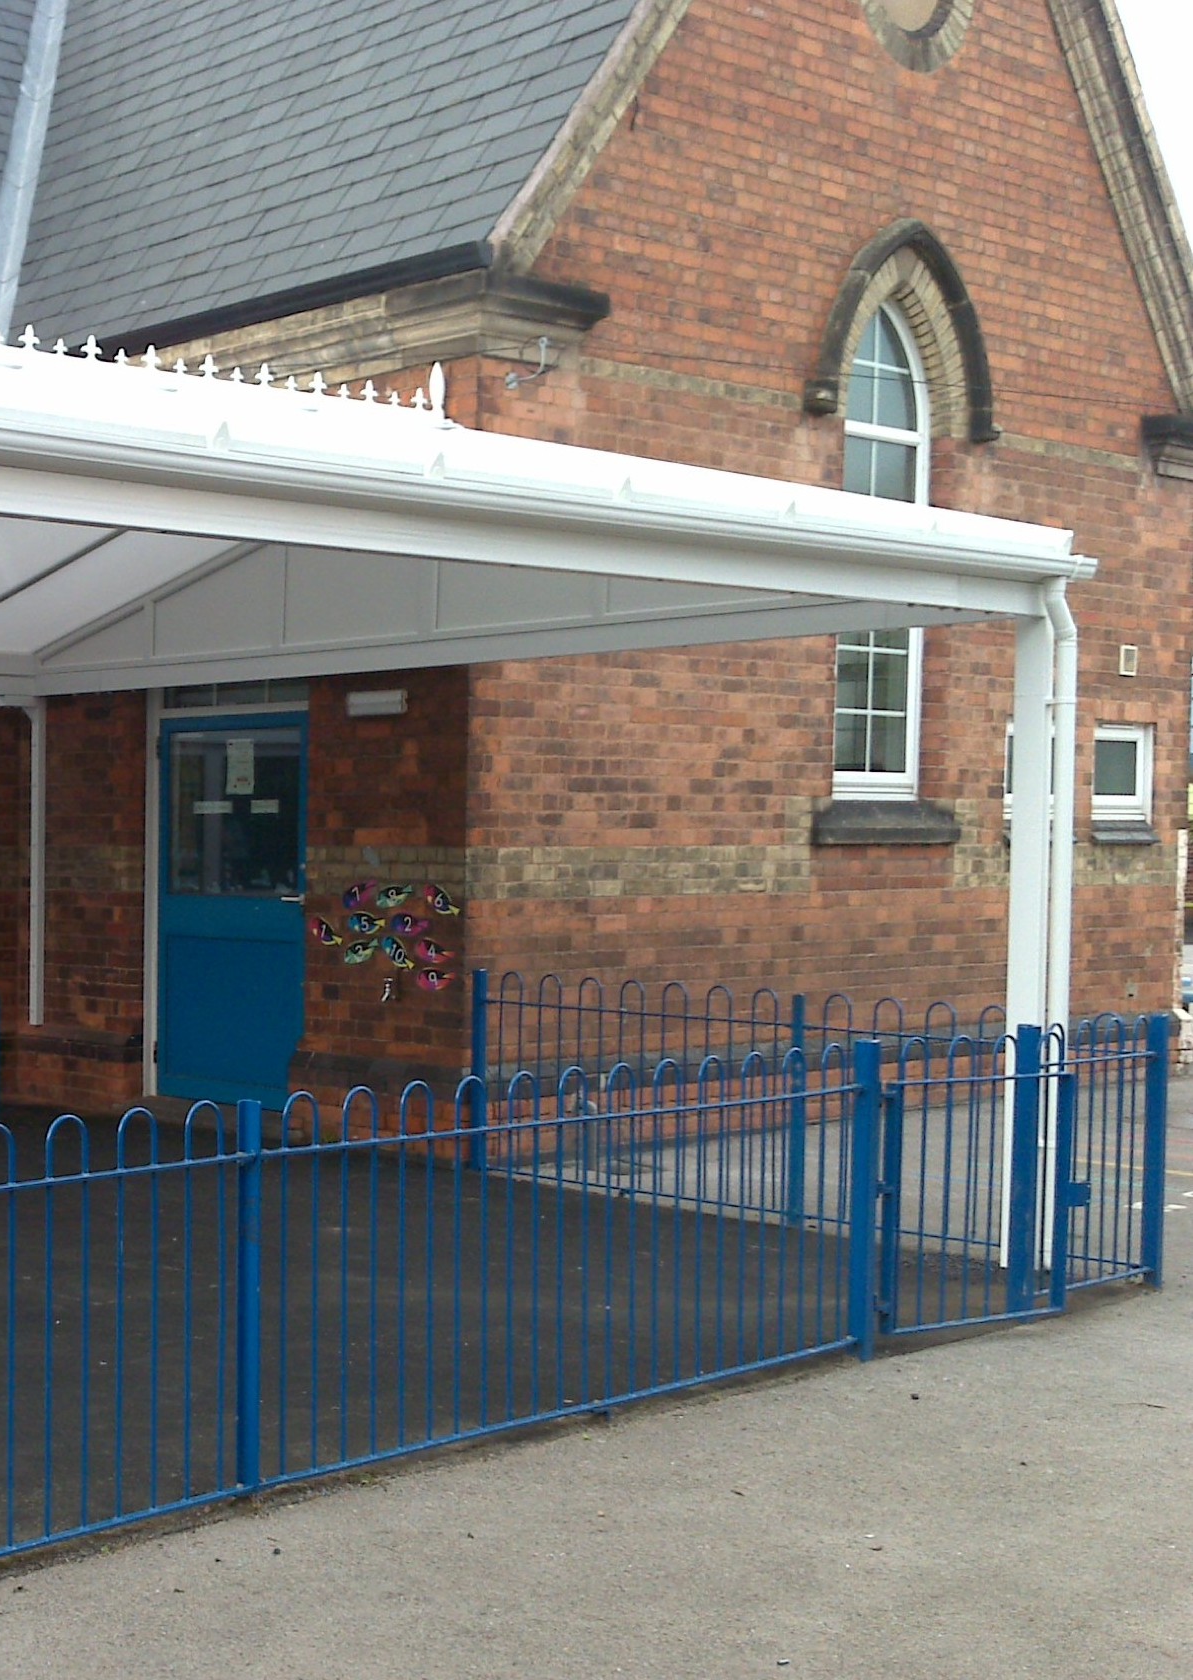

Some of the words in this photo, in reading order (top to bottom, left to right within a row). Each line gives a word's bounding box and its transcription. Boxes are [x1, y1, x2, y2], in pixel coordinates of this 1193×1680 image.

[434, 892, 443, 908] 6
[320, 924, 327, 938] 1
[361, 916, 370, 931] 5
[403, 916, 412, 932] 2
[390, 944, 405, 963] 10
[427, 944, 436, 959] 4
[428, 971, 438, 986] 9
